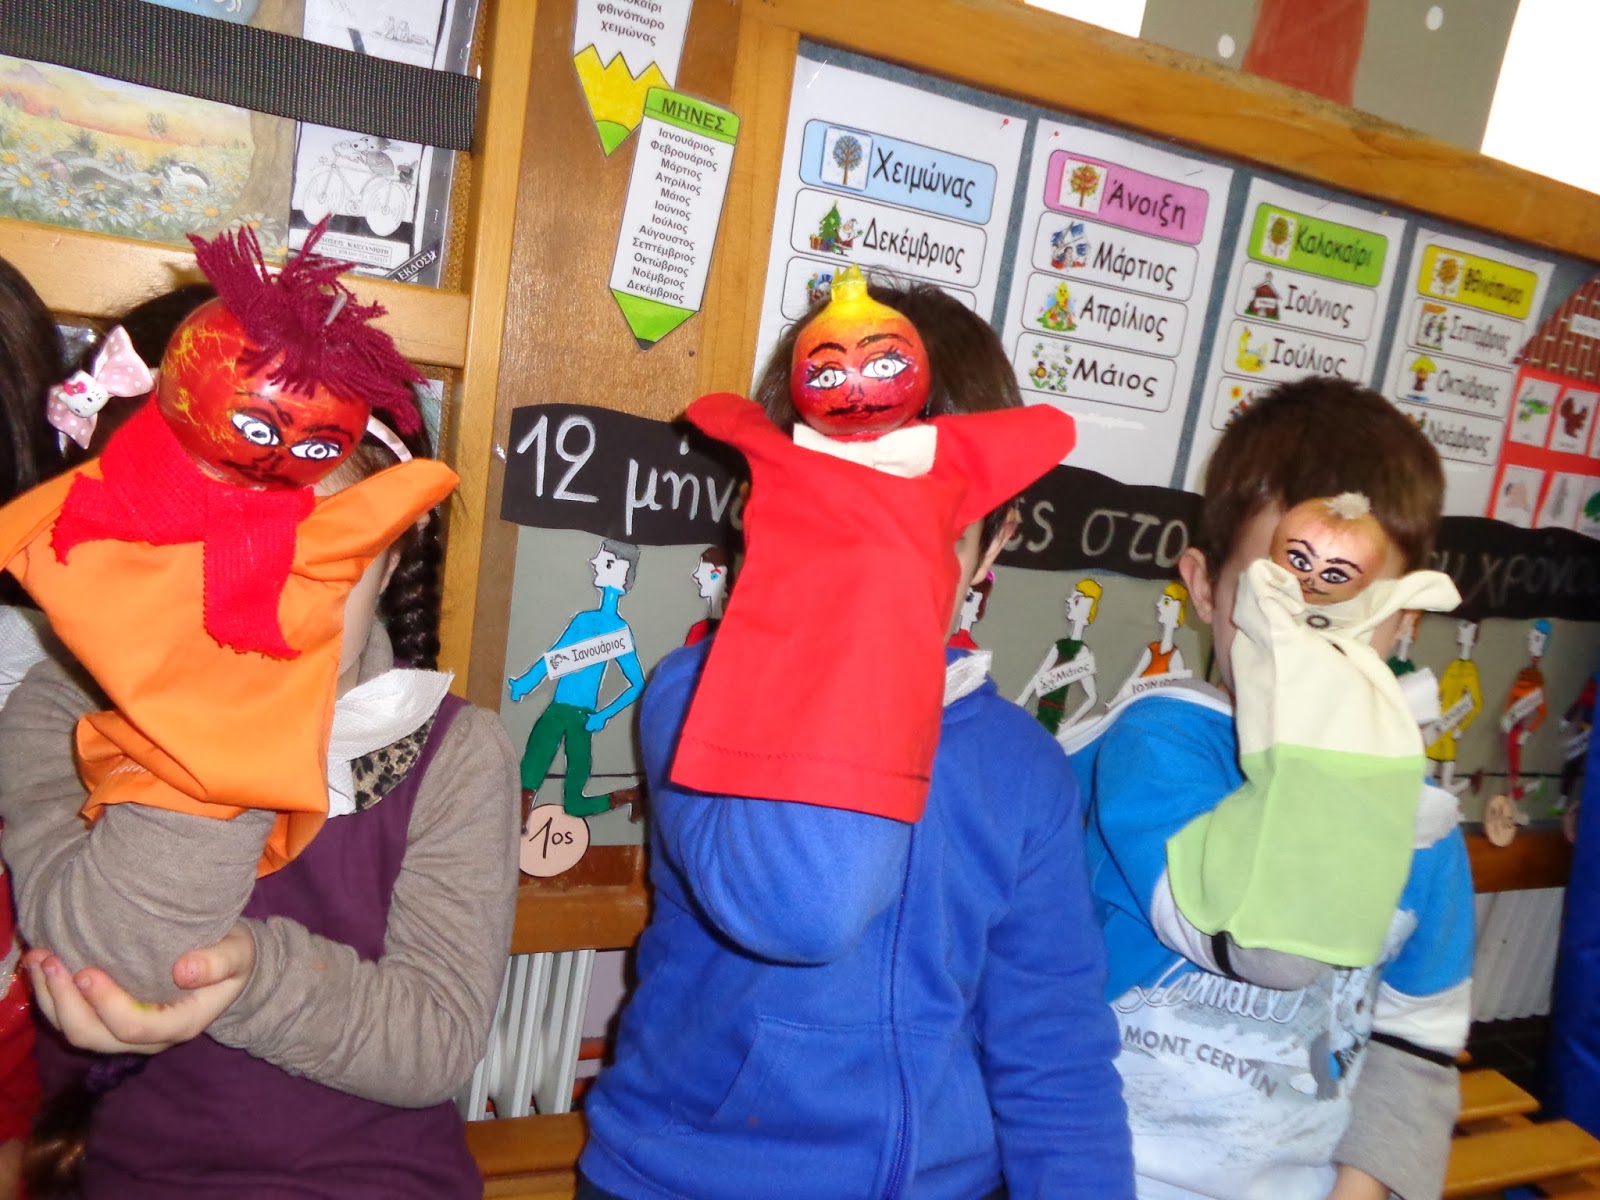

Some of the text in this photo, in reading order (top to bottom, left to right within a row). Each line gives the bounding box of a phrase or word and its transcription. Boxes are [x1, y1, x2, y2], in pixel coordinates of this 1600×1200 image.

[597, 3, 665, 30] φθινόπωρο
[601, 20, 657, 47] χειμώνας
[661, 98, 726, 132] ΜΗΝΕΣ
[650, 140, 718, 171] Φεβρουάριος
[659, 128, 715, 156] Ιανουάριος
[655, 172, 701, 195] Απρίλιος
[660, 158, 702, 181] Μάρτιος
[872, 147, 976, 208] Χειμώνας
[654, 200, 692, 221] Ιούνιος
[660, 187, 692, 207] Μάιος
[1106, 180, 1186, 229] Άνοιξη
[638, 224, 695, 250] Αύγουστος
[651, 214, 689, 234] Ιούλιος
[632, 237, 696, 265] Σεπτέμβριος
[862, 217, 965, 274] Δεκέμβριος
[1295, 225, 1372, 270] Καλοκαίρι
[632, 266, 685, 290] Νοέμβριος
[634, 253, 689, 277] Οκτώβριος
[1093, 242, 1177, 291] Μάρτιος
[626, 279, 685, 304] Δεκέμβριος
[1080, 295, 1168, 342] Απρίλιος
[1284, 284, 1354, 329] Ιούνιος
[1270, 338, 1347, 377] Ιούλιος
[1072, 358, 1158, 397] Μάιος
[516, 414, 600, 503] 12
[571, 637, 626, 662] Ιανουάριος
[1056, 663, 1090, 681] Μάιος
[1125, 1025, 1279, 1098] MONT CERVIN
